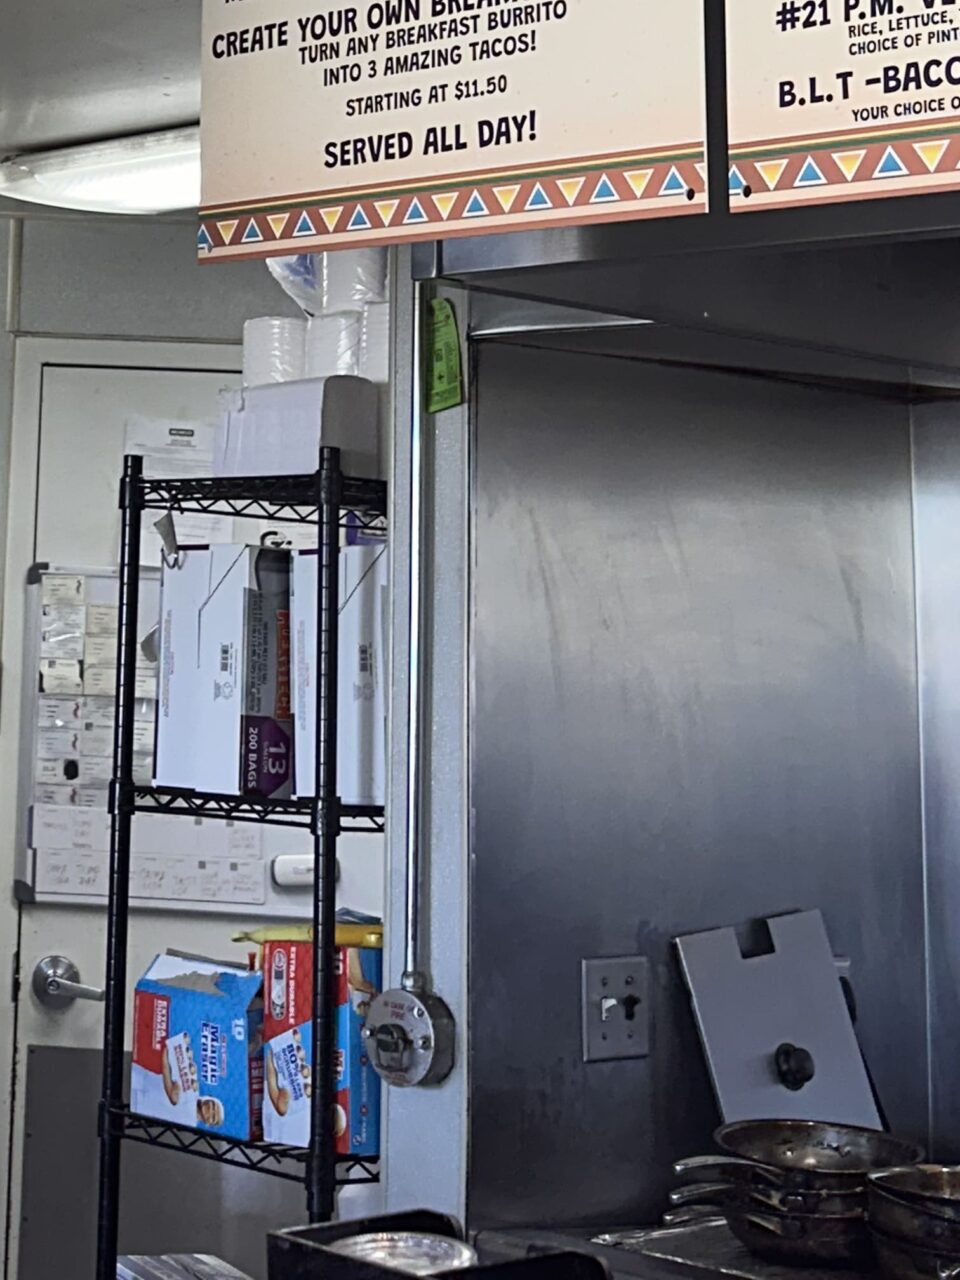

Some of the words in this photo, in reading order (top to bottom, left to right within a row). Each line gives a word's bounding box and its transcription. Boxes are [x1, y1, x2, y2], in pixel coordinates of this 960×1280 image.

[211, 20, 288, 59] CREATE
[297, 7, 357, 42] YOUR
[298, 41, 340, 65] TURN
[345, 33, 380, 57] ANY
[385, 14, 480, 49] BREAKFAST
[323, 62, 361, 87] INTO
[367, 59, 377, 78] 3
[383, 44, 462, 76] AMAZING
[468, 29, 536, 61] TACOS!
[778, 70, 853, 108] B.L.T
[324, 131, 413, 168] SERVED
[422, 123, 467, 156] ALL
[477, 109, 536, 148] DAY!
[248, 727, 258, 750] 200
[268, 741, 286, 774] 13
[247, 753, 258, 788] BAGS
